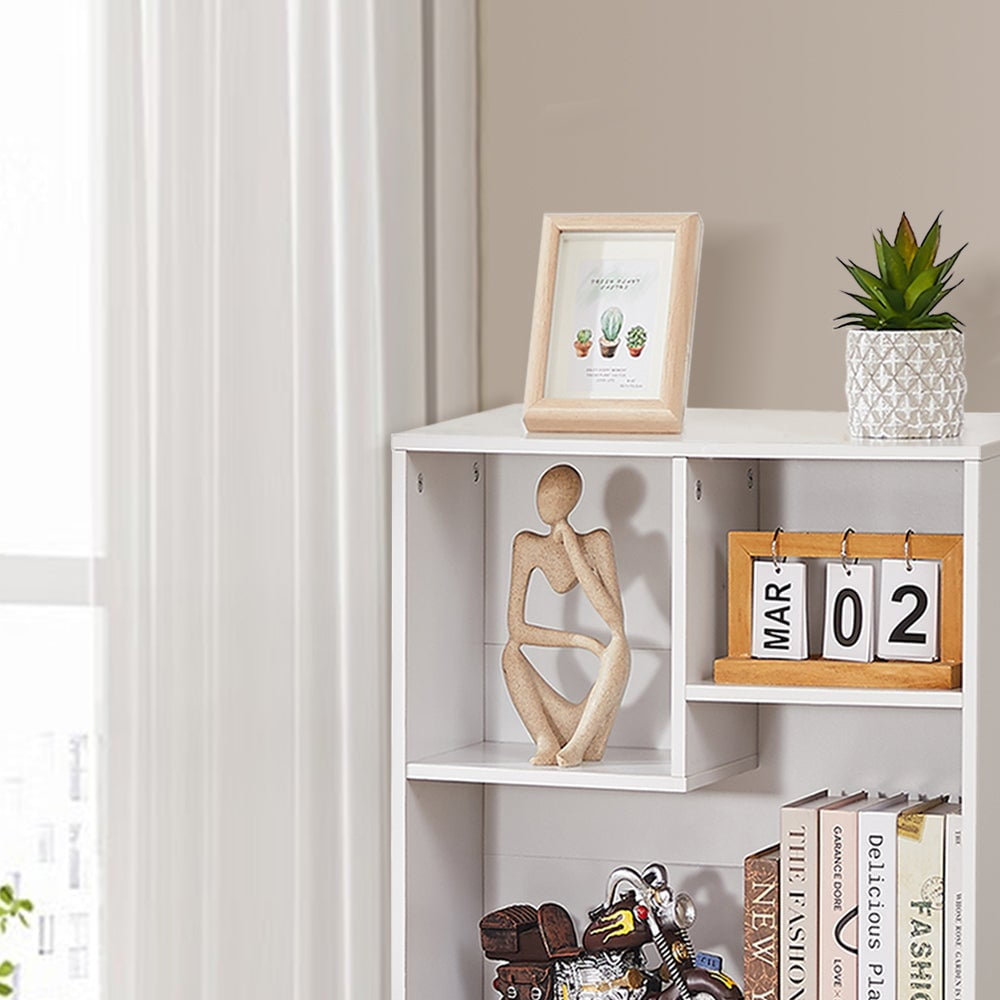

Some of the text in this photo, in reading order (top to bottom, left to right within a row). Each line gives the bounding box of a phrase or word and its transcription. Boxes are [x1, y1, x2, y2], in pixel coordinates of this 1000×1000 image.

[763, 582, 792, 651] MAR
[788, 825, 806, 883] THE
[832, 826, 843, 881] GARANCE
[750, 880, 775, 966] NEW
[867, 834, 884, 950] Delicious
[832, 959, 842, 988] LOVE
